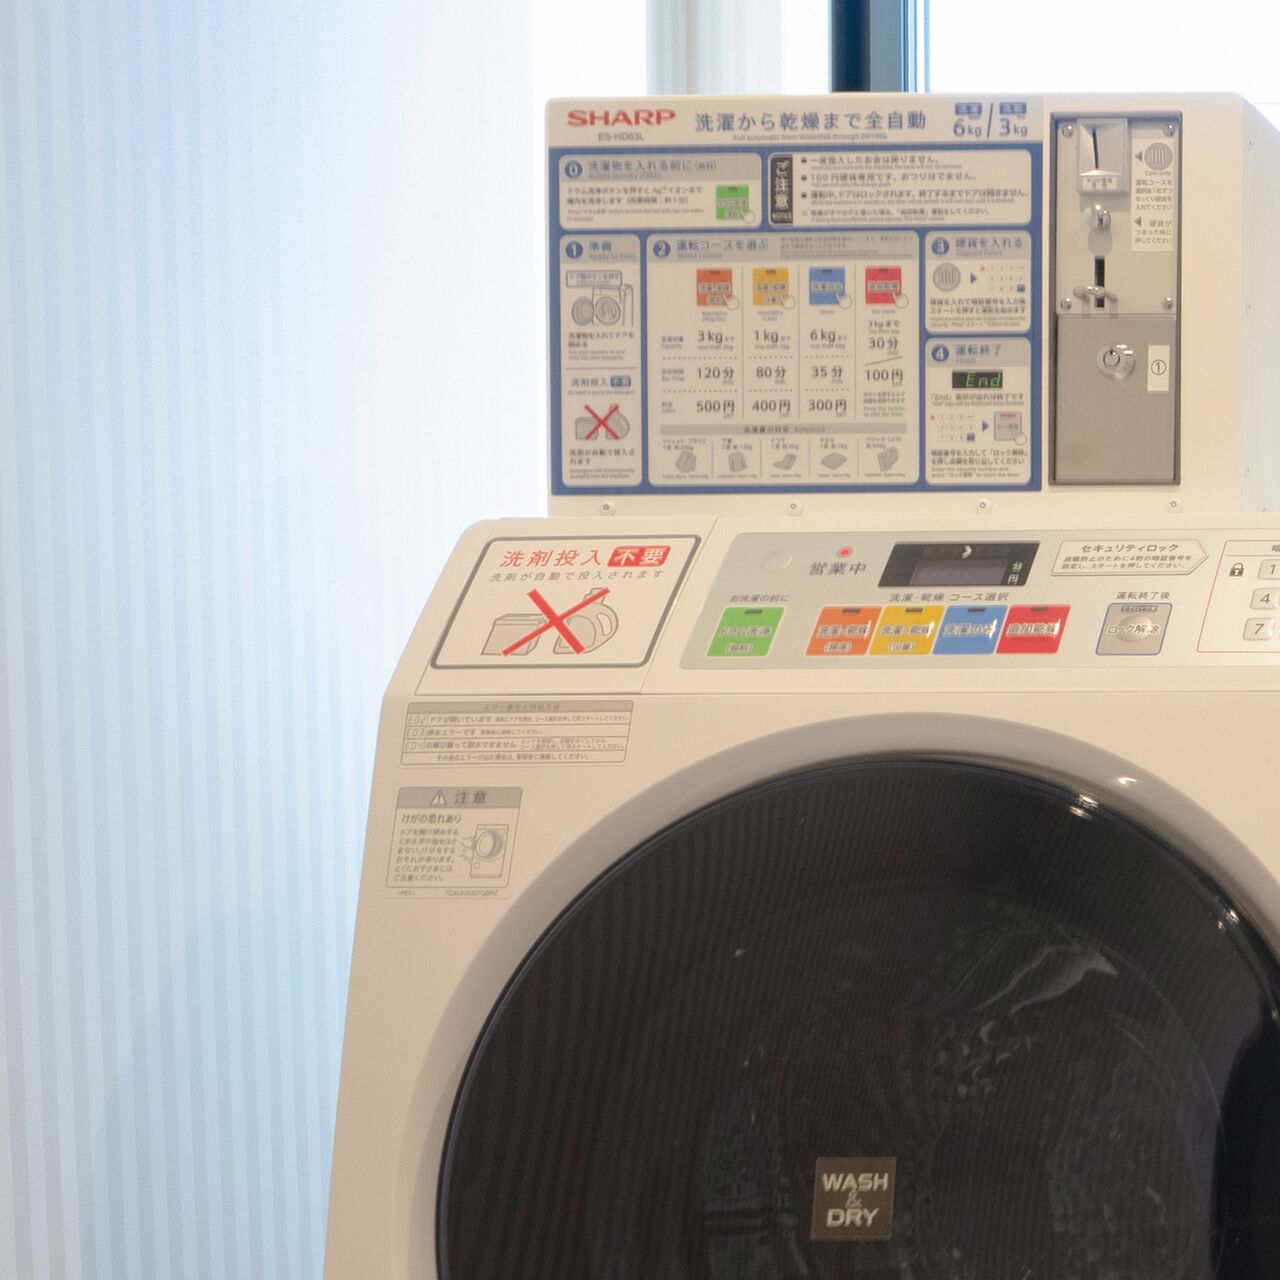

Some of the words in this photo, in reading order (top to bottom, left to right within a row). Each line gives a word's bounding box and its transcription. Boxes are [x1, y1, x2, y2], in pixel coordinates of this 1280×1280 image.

[567, 110, 676, 126] SHARP
[695, 110, 926, 132] 洗濯から乾燥まで全自動
[1081, 544, 1179, 552] セキュリティロック
[500, 550, 602, 567] 洗剤投入
[614, 549, 665, 566] 不要
[809, 561, 867, 575] 営業中
[1270, 564, 1276, 575] 1
[490, 571, 664, 582] 洗剤が自動で投入されます
[950, 592, 1010, 601] コース選択
[1116, 592, 1170, 600] 運転終了後
[1260, 593, 1270, 604] 4
[1254, 624, 1264, 635] 7
[454, 790, 488, 805] 注意
[401, 814, 461, 824] けがの恐れあり
[822, 1173, 888, 1192] WASH
[827, 1208, 880, 1227] DRY
